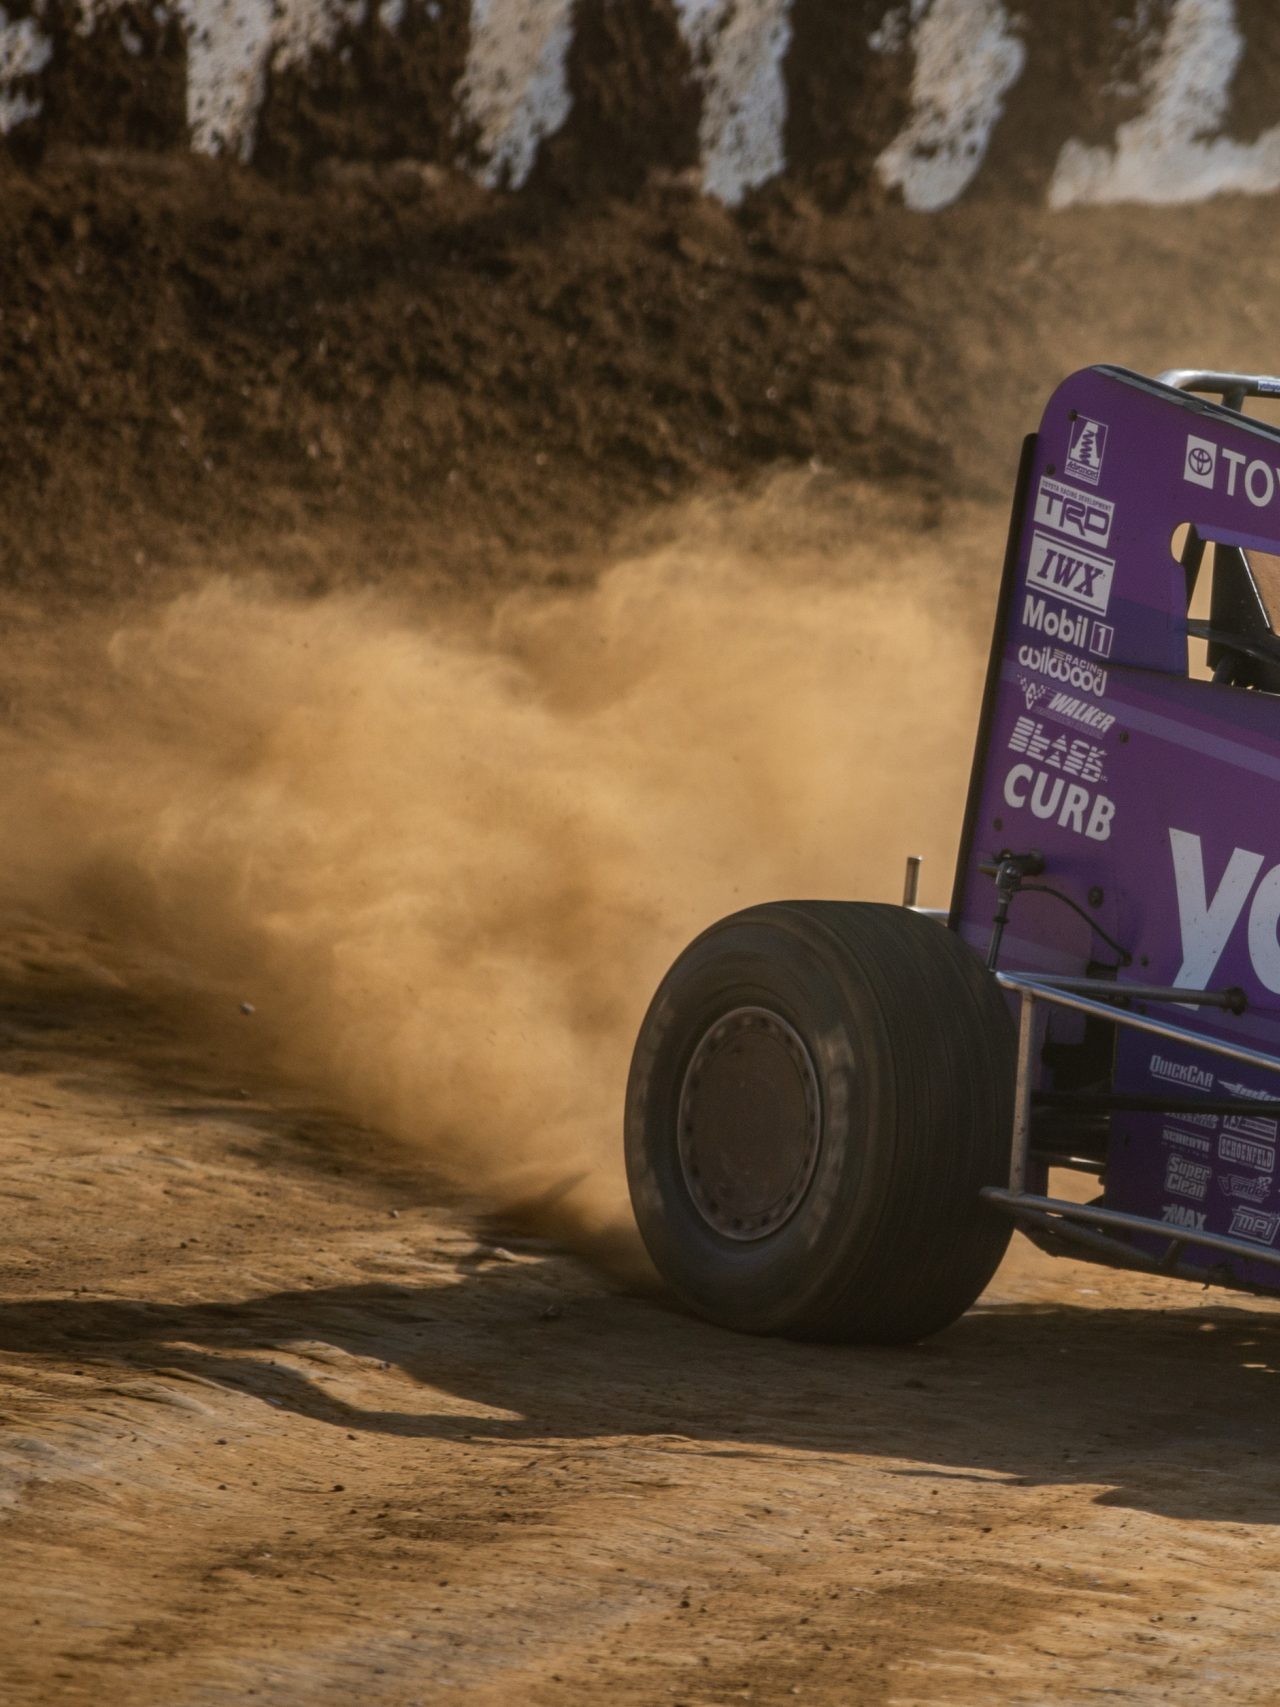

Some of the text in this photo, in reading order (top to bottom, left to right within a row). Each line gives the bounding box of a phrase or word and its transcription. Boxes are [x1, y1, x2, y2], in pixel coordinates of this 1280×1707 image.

[1040, 487, 1110, 537] TRD
[1037, 549, 1104, 598] IWX
[1022, 594, 1089, 649] Mobil
[1018, 645, 1108, 697] wilwood
[1048, 692, 1116, 733] WALKER
[1004, 763, 1116, 841] CURB
[1166, 1174, 1207, 1199] Clean
[1168, 1156, 1211, 1181] Super
